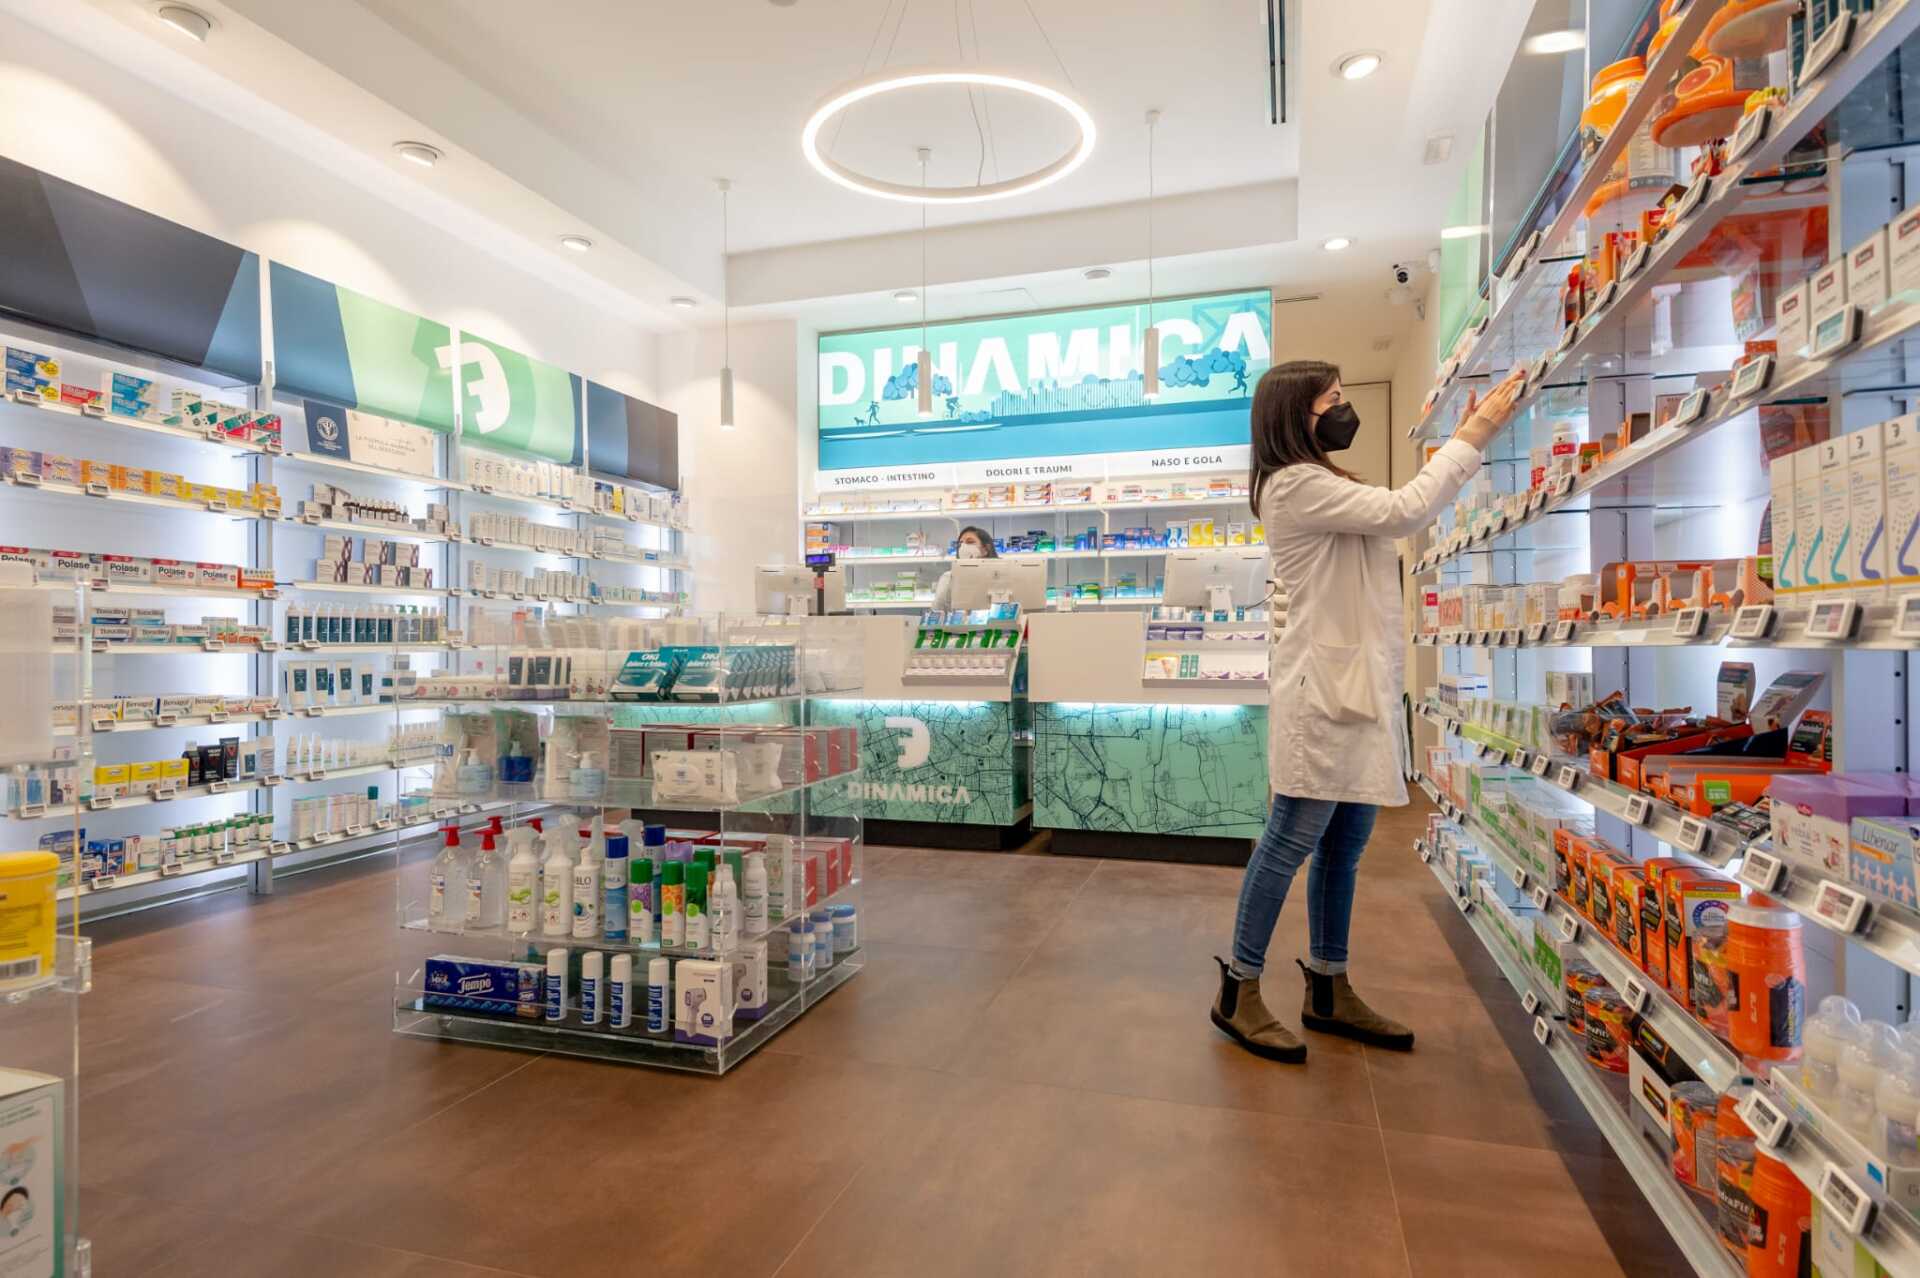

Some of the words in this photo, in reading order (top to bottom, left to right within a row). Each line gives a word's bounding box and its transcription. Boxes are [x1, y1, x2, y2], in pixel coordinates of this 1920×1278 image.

[819, 311, 1271, 406] DINAMICA
[1151, 457, 1180, 468] NASO
[1193, 454, 1223, 466] GOLA
[985, 467, 1023, 478] DOLORI
[1034, 464, 1072, 475] TRAUMI
[834, 475, 879, 486] STOMACO
[886, 472, 936, 483] INTESTINO
[58, 559, 90, 570] Polase
[110, 563, 139, 573] Polase
[158, 566, 186, 576] Polase
[202, 569, 228, 579] Polase
[847, 781, 972, 805] DINAMICA
[458, 973, 494, 997] Tempo
